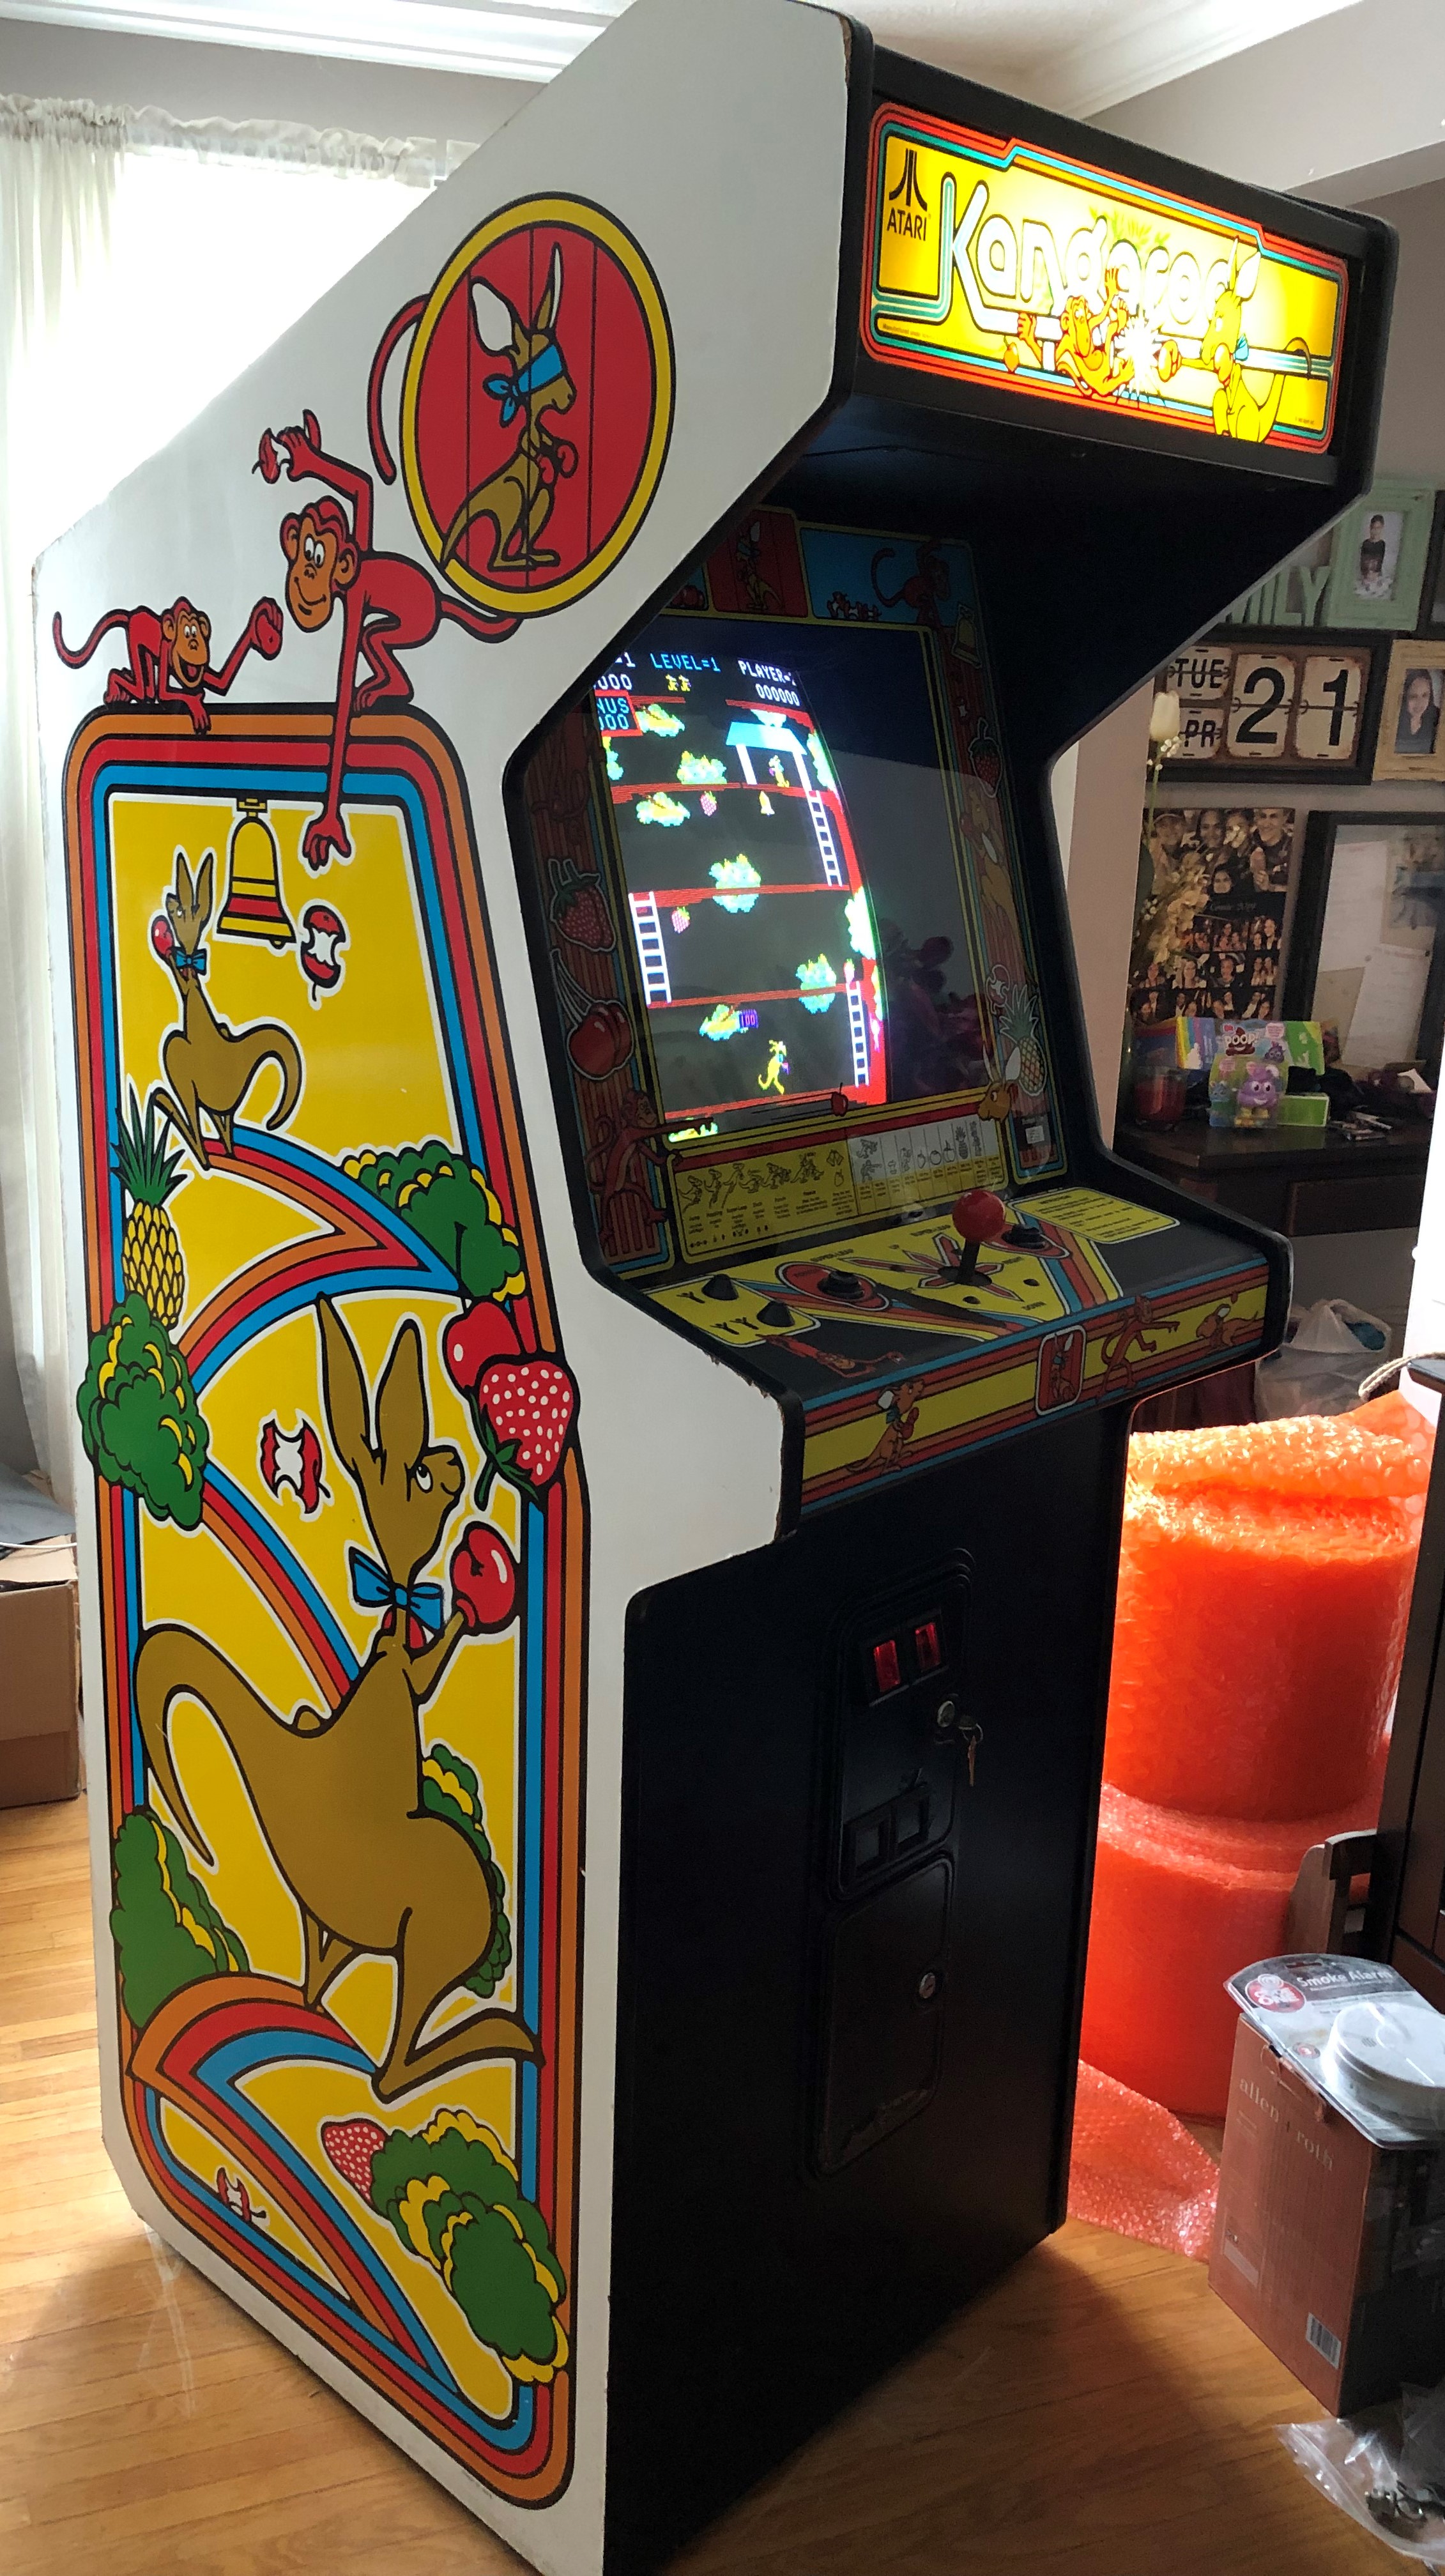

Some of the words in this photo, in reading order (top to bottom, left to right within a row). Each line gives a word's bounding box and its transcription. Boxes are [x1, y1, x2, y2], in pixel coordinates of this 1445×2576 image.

[886, 206, 927, 241] ATARI
[650, 652, 721, 673] LEVEL=1
[1174, 658, 1225, 689] TUE
[597, 697, 630, 714] NUS
[755, 683, 800, 707] 000000
[1183, 719, 1217, 748] PR
[741, 1013, 756, 1027] 100
[1223, 1032, 1259, 1046] POOP!
[1296, 1972, 1347, 1988] Smoke
[1348, 1970, 1393, 1981] Alarm
[1239, 2078, 1280, 2123] allen
[1296, 2130, 1334, 2172] roth
